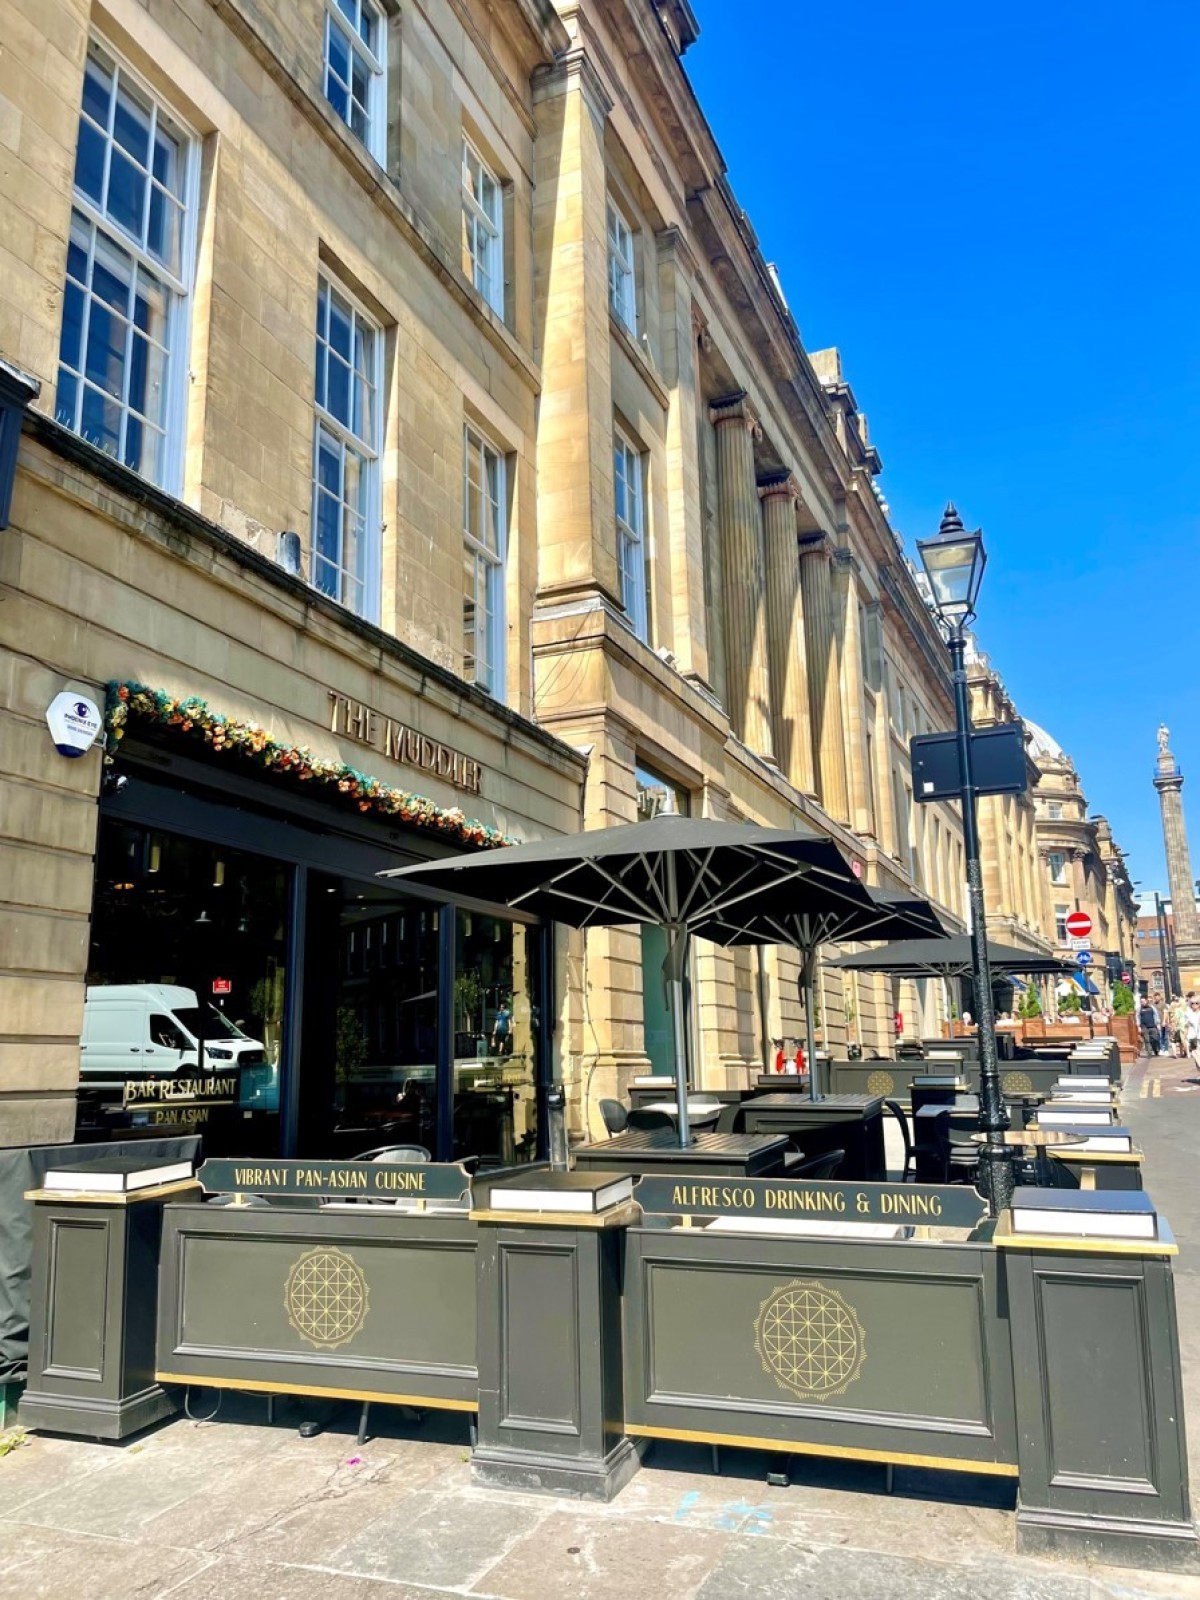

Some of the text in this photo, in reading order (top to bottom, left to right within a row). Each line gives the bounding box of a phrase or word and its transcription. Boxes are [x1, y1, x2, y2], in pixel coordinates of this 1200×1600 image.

[328, 691, 482, 794] THE MUDDLER
[125, 1078, 237, 1101] BAR RESTAURANT
[155, 1108, 209, 1124] PAN ASIAN
[234, 1168, 426, 1191] VIBRANT PAN-ASIAN CUISINE
[672, 1185, 942, 1217] ALFRESCO DRINKING & DINING
